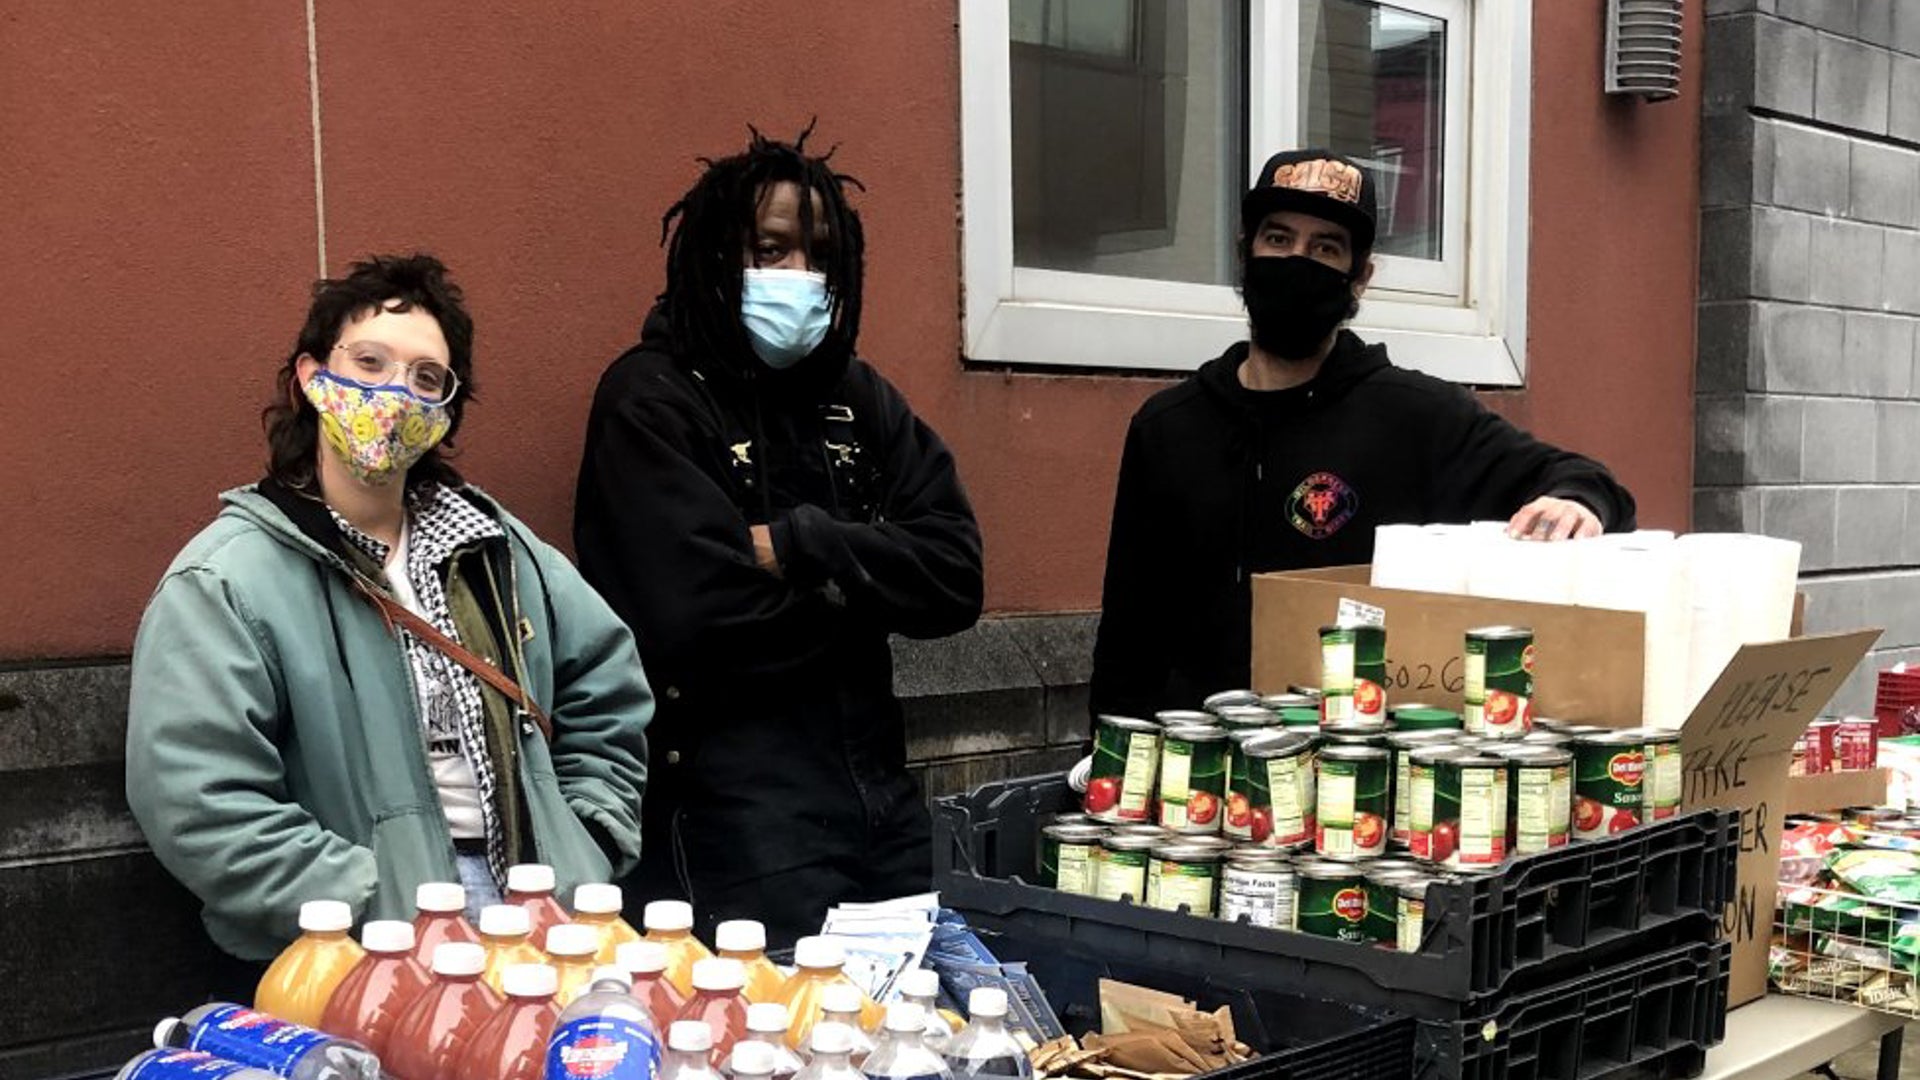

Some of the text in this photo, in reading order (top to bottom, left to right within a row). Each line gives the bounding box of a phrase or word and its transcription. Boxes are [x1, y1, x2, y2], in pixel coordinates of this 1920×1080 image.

[1705, 667, 1831, 736] PLEASE
[1682, 734, 1768, 803] TAKE
[1740, 801, 1768, 853] ER
[1714, 884, 1756, 943] ON
